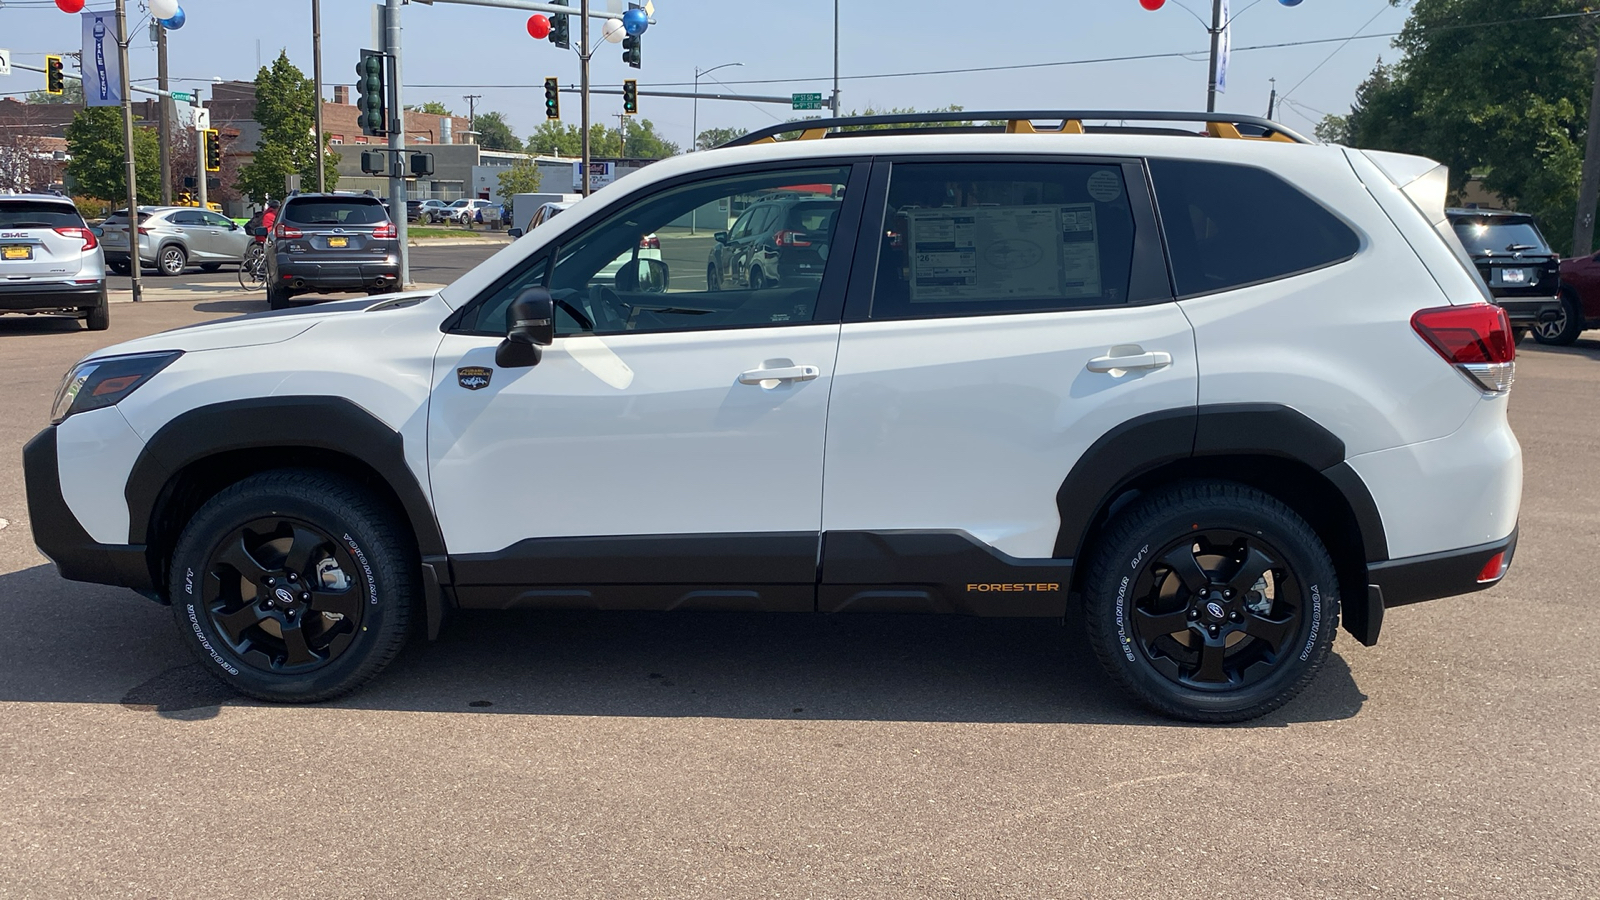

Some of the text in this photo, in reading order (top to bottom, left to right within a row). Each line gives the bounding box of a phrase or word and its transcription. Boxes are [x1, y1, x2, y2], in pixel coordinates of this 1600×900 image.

[99, 70, 107, 97] EVENT
[171, 92, 190, 101] Central
[343, 533, 378, 605] YOKOHAMA
[966, 583, 1060, 592] FORESTER
[1115, 544, 1149, 662] GEOLANDAR A/T
[186, 603, 239, 676] GEOLANDAR
[1299, 584, 1321, 662] YOKOHAMA
